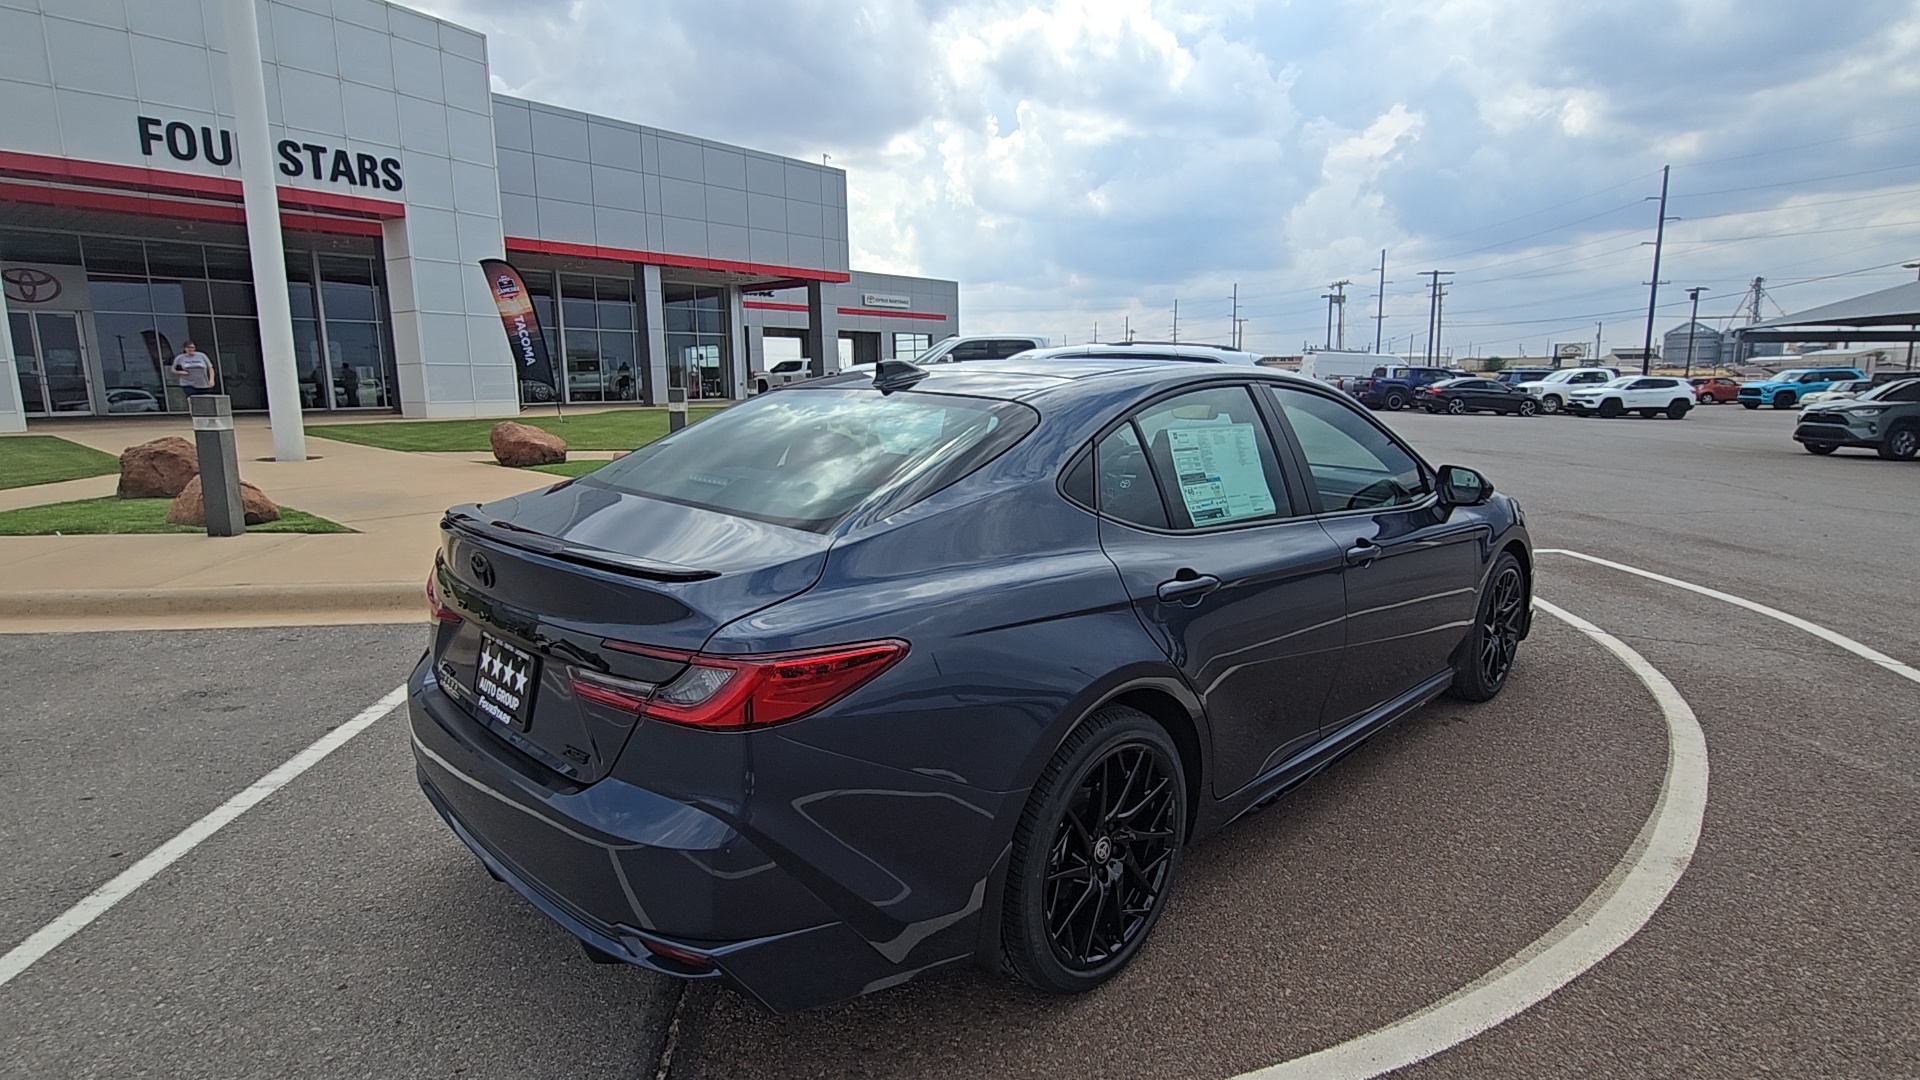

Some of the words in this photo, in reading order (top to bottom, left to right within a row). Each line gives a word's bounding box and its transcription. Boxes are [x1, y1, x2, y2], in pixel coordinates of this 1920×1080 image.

[137, 115, 242, 169] FOU
[277, 139, 403, 192] STARS
[514, 315, 537, 367] TACOMA
[478, 676, 497, 698] AUTO
[496, 687, 520, 711] GROUP
